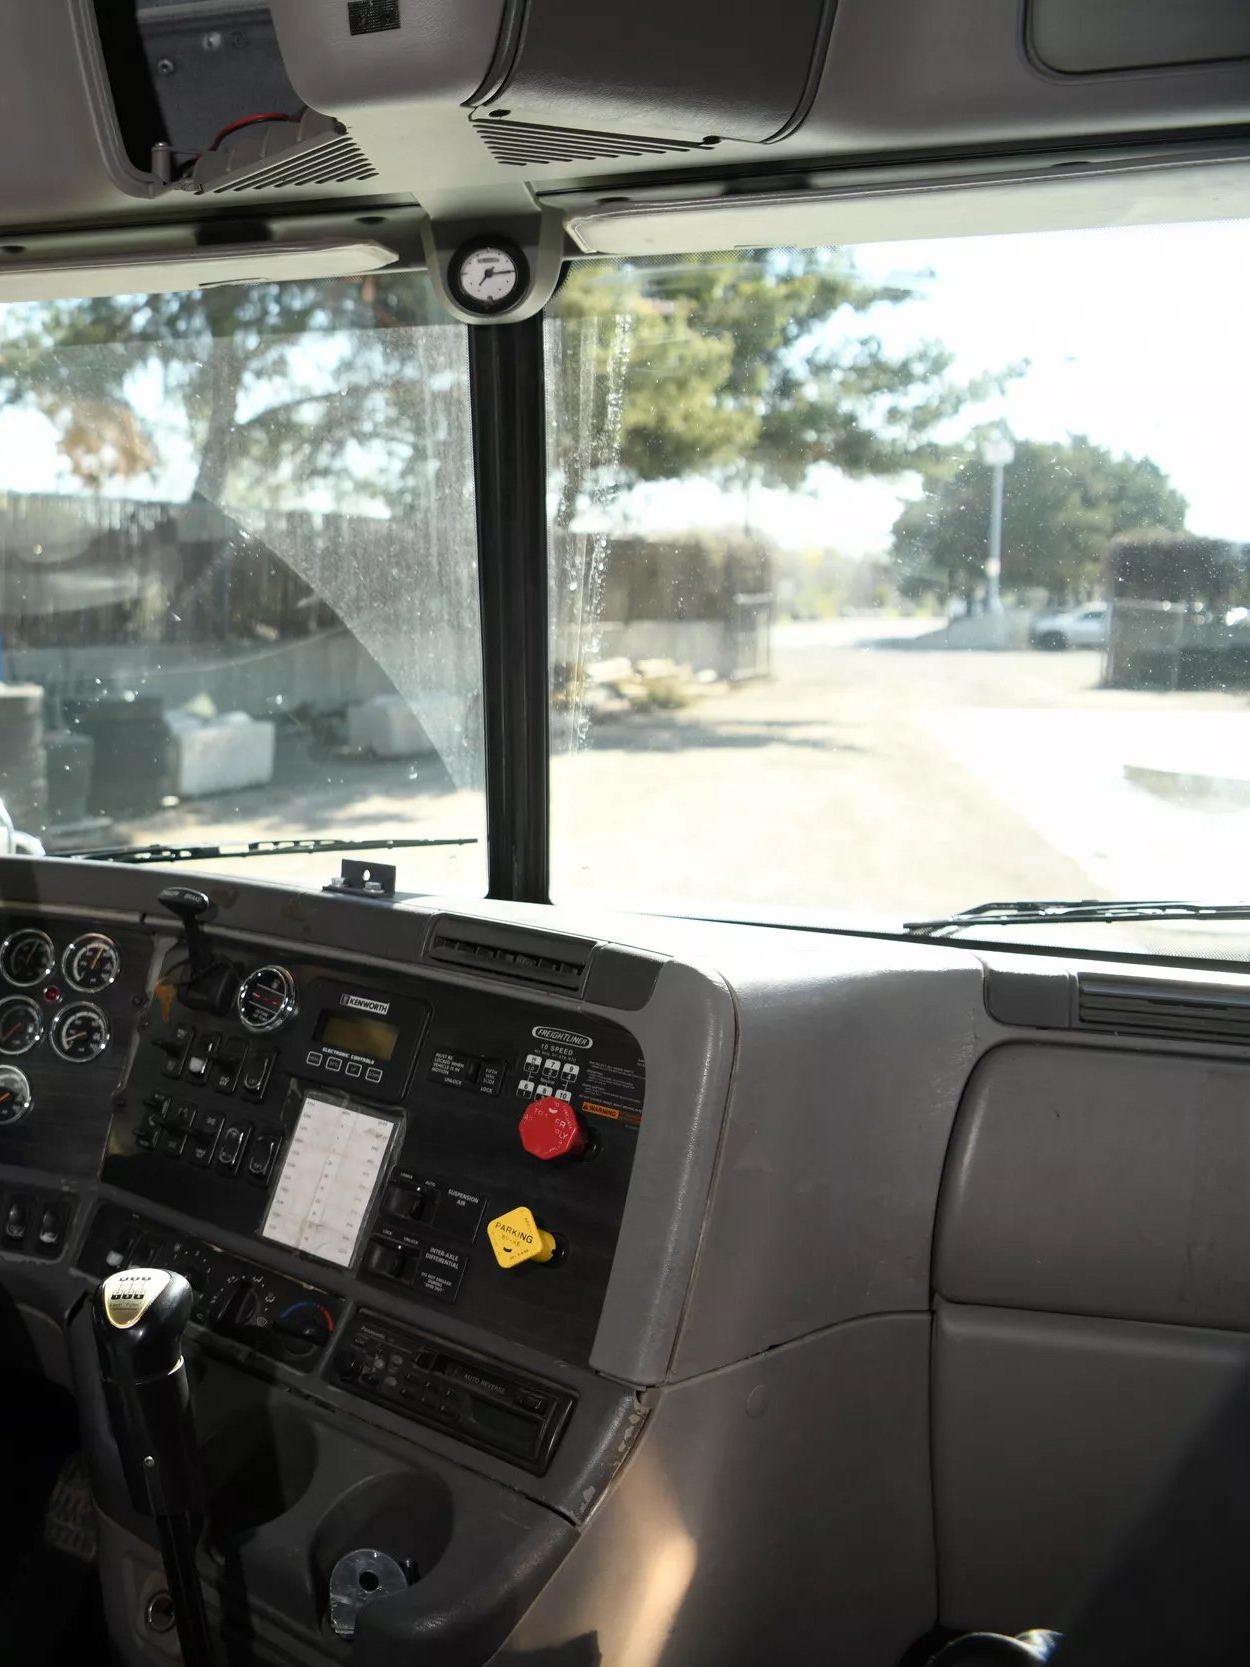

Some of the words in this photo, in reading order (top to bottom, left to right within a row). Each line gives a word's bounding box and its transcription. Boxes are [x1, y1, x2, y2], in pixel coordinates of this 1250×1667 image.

[348, 997, 389, 1014] KENWORTH
[536, 1028, 589, 1047] FREIGHTLINER
[322, 1046, 350, 1059] ELECTRONIC
[350, 1054, 376, 1066] CONTROLS
[541, 1043, 549, 1051] 10
[550, 1045, 574, 1057] SPEED
[444, 1077, 462, 1086] UNLOCK
[480, 1086, 493, 1094] LOCK
[589, 1104, 618, 1118] WARNING
[448, 1188, 480, 1204] SUSPENSION
[456, 1199, 466, 1207] AIR
[403, 1236, 419, 1245] UNLOCK
[495, 1221, 534, 1244] PARKING
[425, 1253, 459, 1270] DIFFERENTIAL
[463, 1373, 480, 1385] AUTO
[481, 1379, 506, 1395] REVERSE
